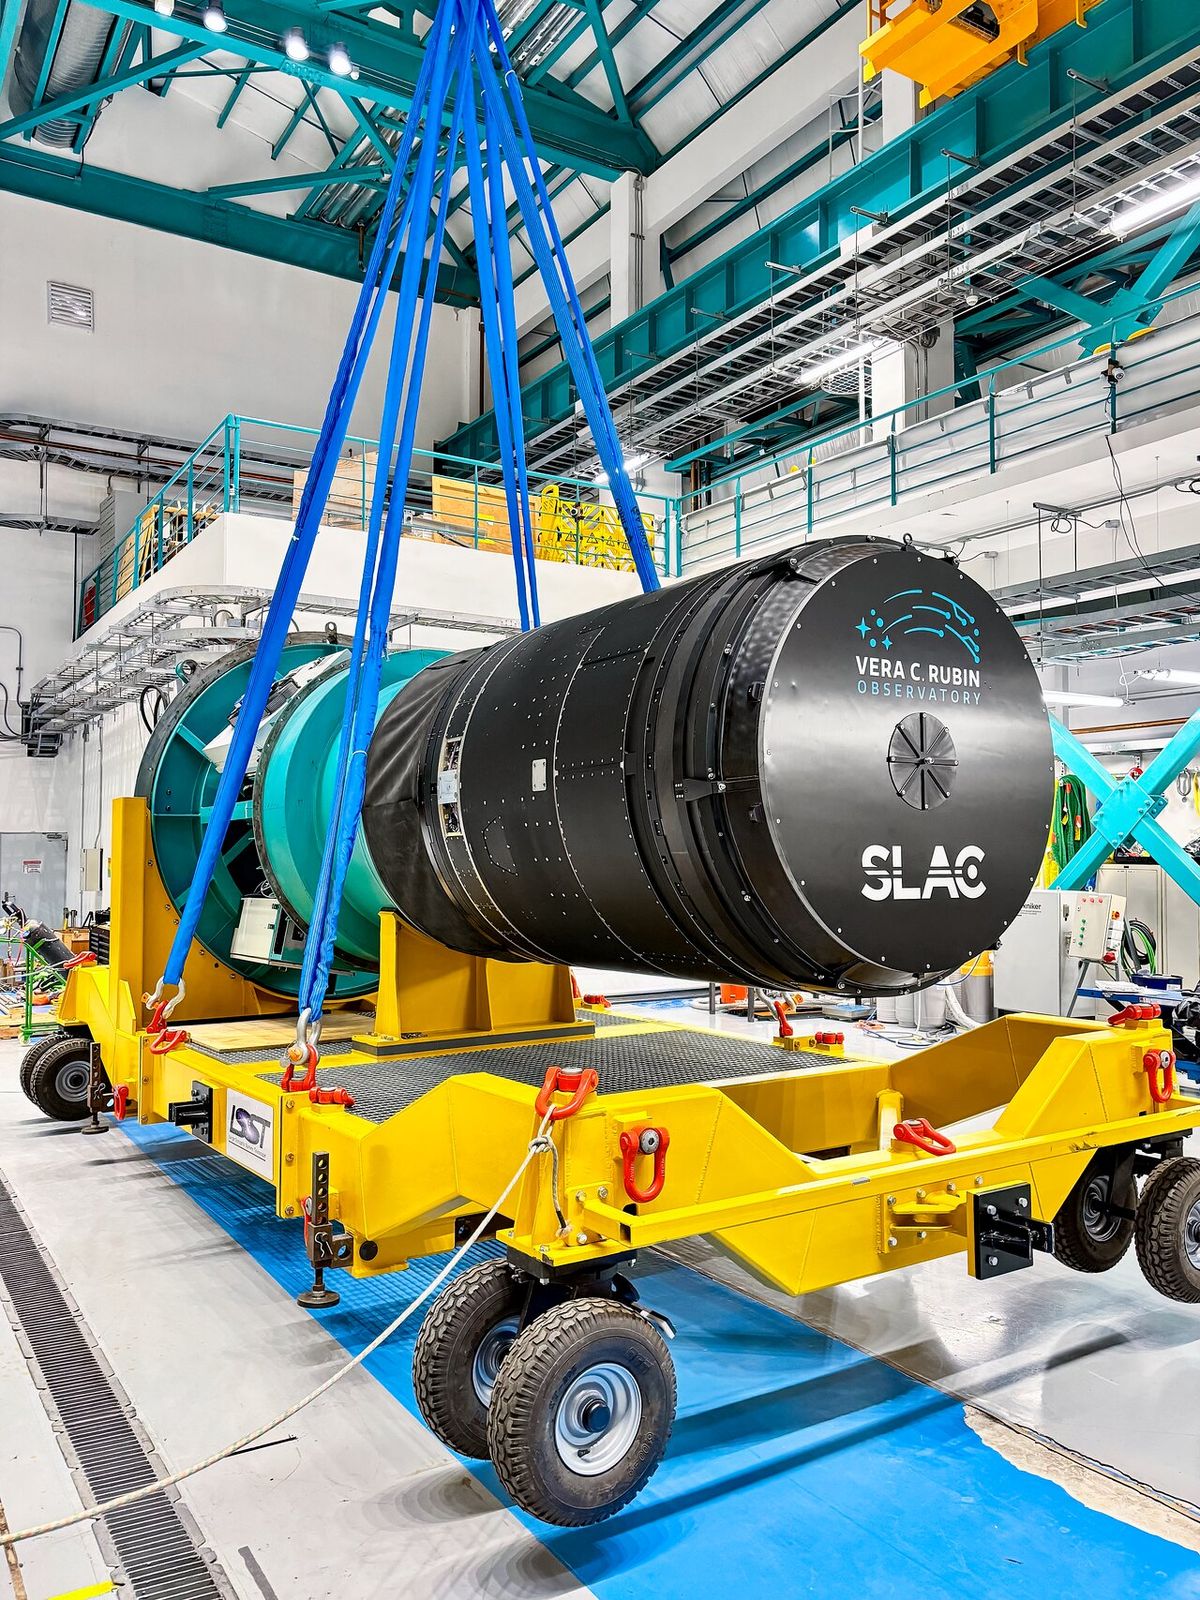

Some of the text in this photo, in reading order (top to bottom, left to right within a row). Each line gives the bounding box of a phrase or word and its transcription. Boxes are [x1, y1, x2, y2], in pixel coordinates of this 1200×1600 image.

[855, 655, 980, 688] VERA C. RUBIN
[857, 680, 981, 705] OBSERVATORY
[860, 844, 987, 901] SLAC
[229, 1104, 271, 1149] LSST
